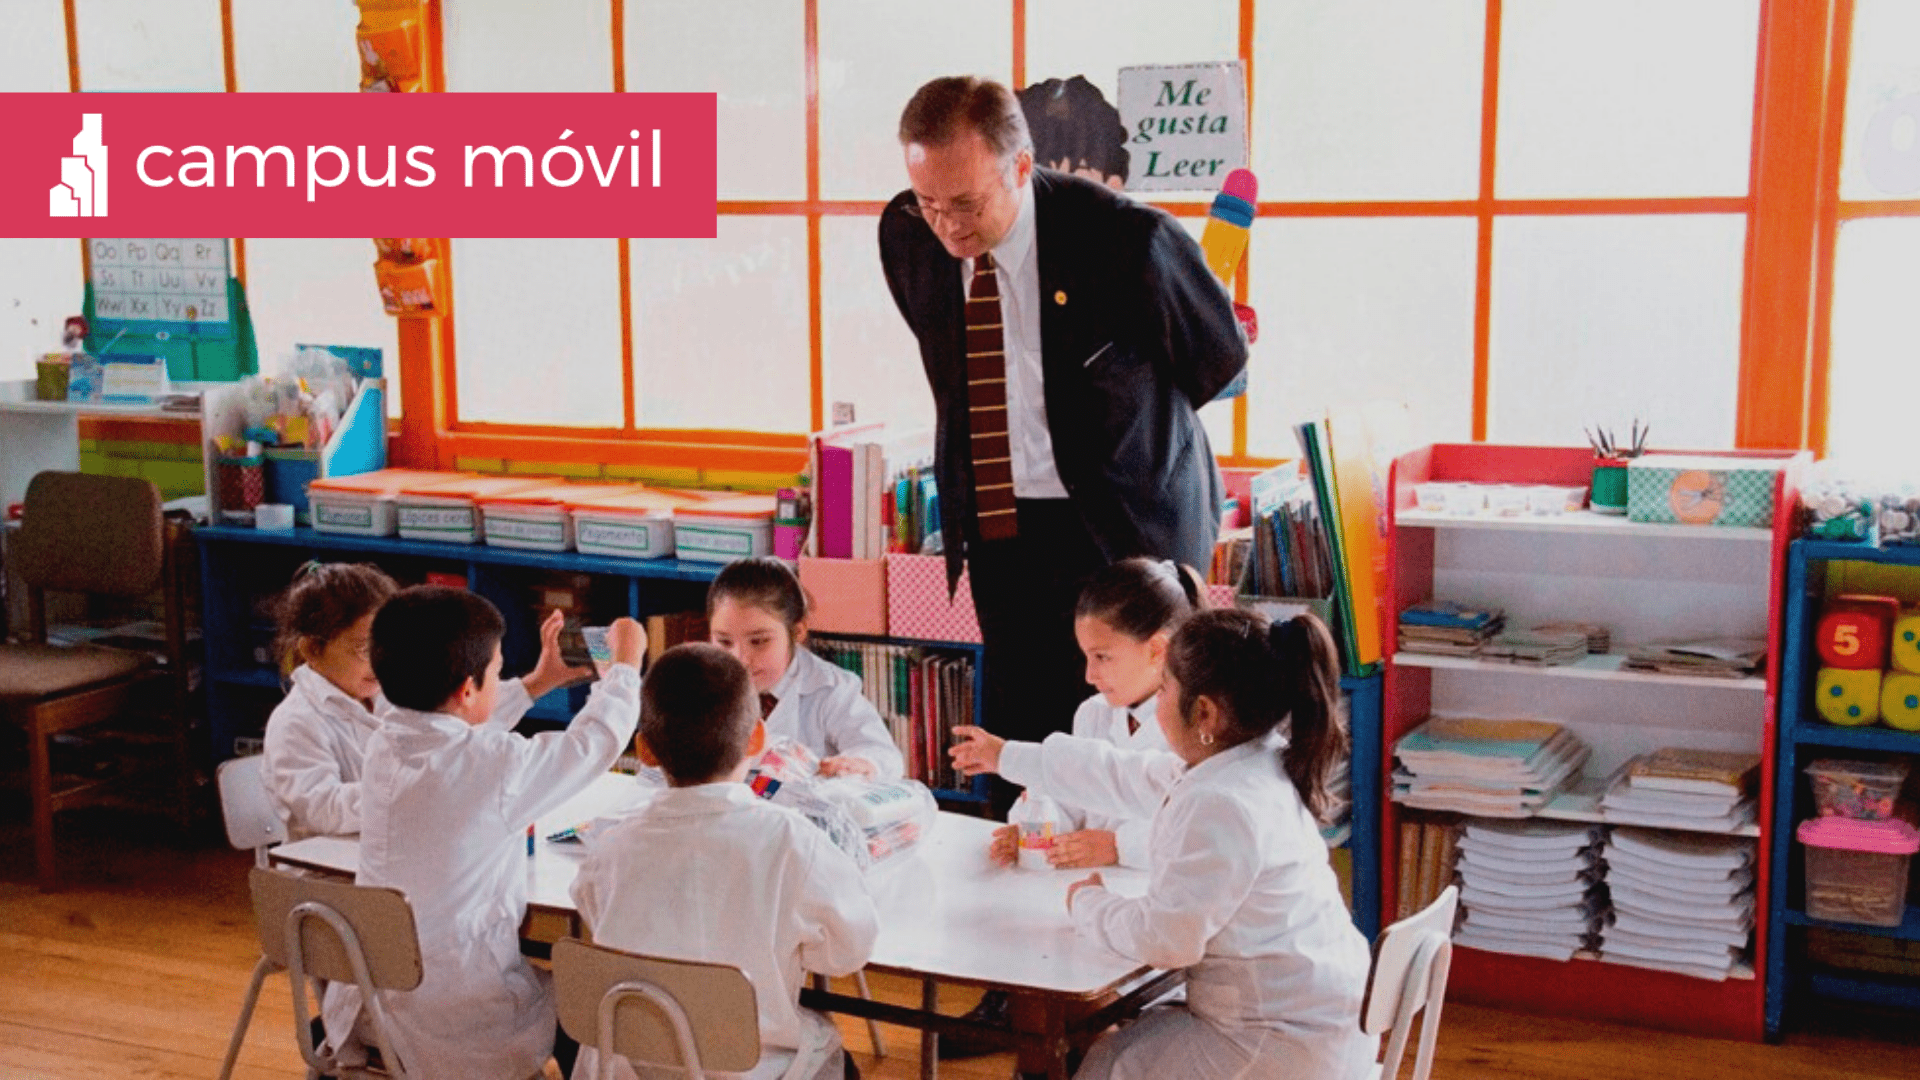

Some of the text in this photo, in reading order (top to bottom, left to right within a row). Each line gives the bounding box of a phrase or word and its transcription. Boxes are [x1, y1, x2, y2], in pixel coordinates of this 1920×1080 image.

[1154, 79, 1211, 107] Me
[1132, 112, 1228, 144] gusta
[1142, 151, 1225, 178] Leer
[95, 241, 117, 260] Oo
[159, 271, 180, 288] Uu
[1832, 624, 1860, 656] 5
